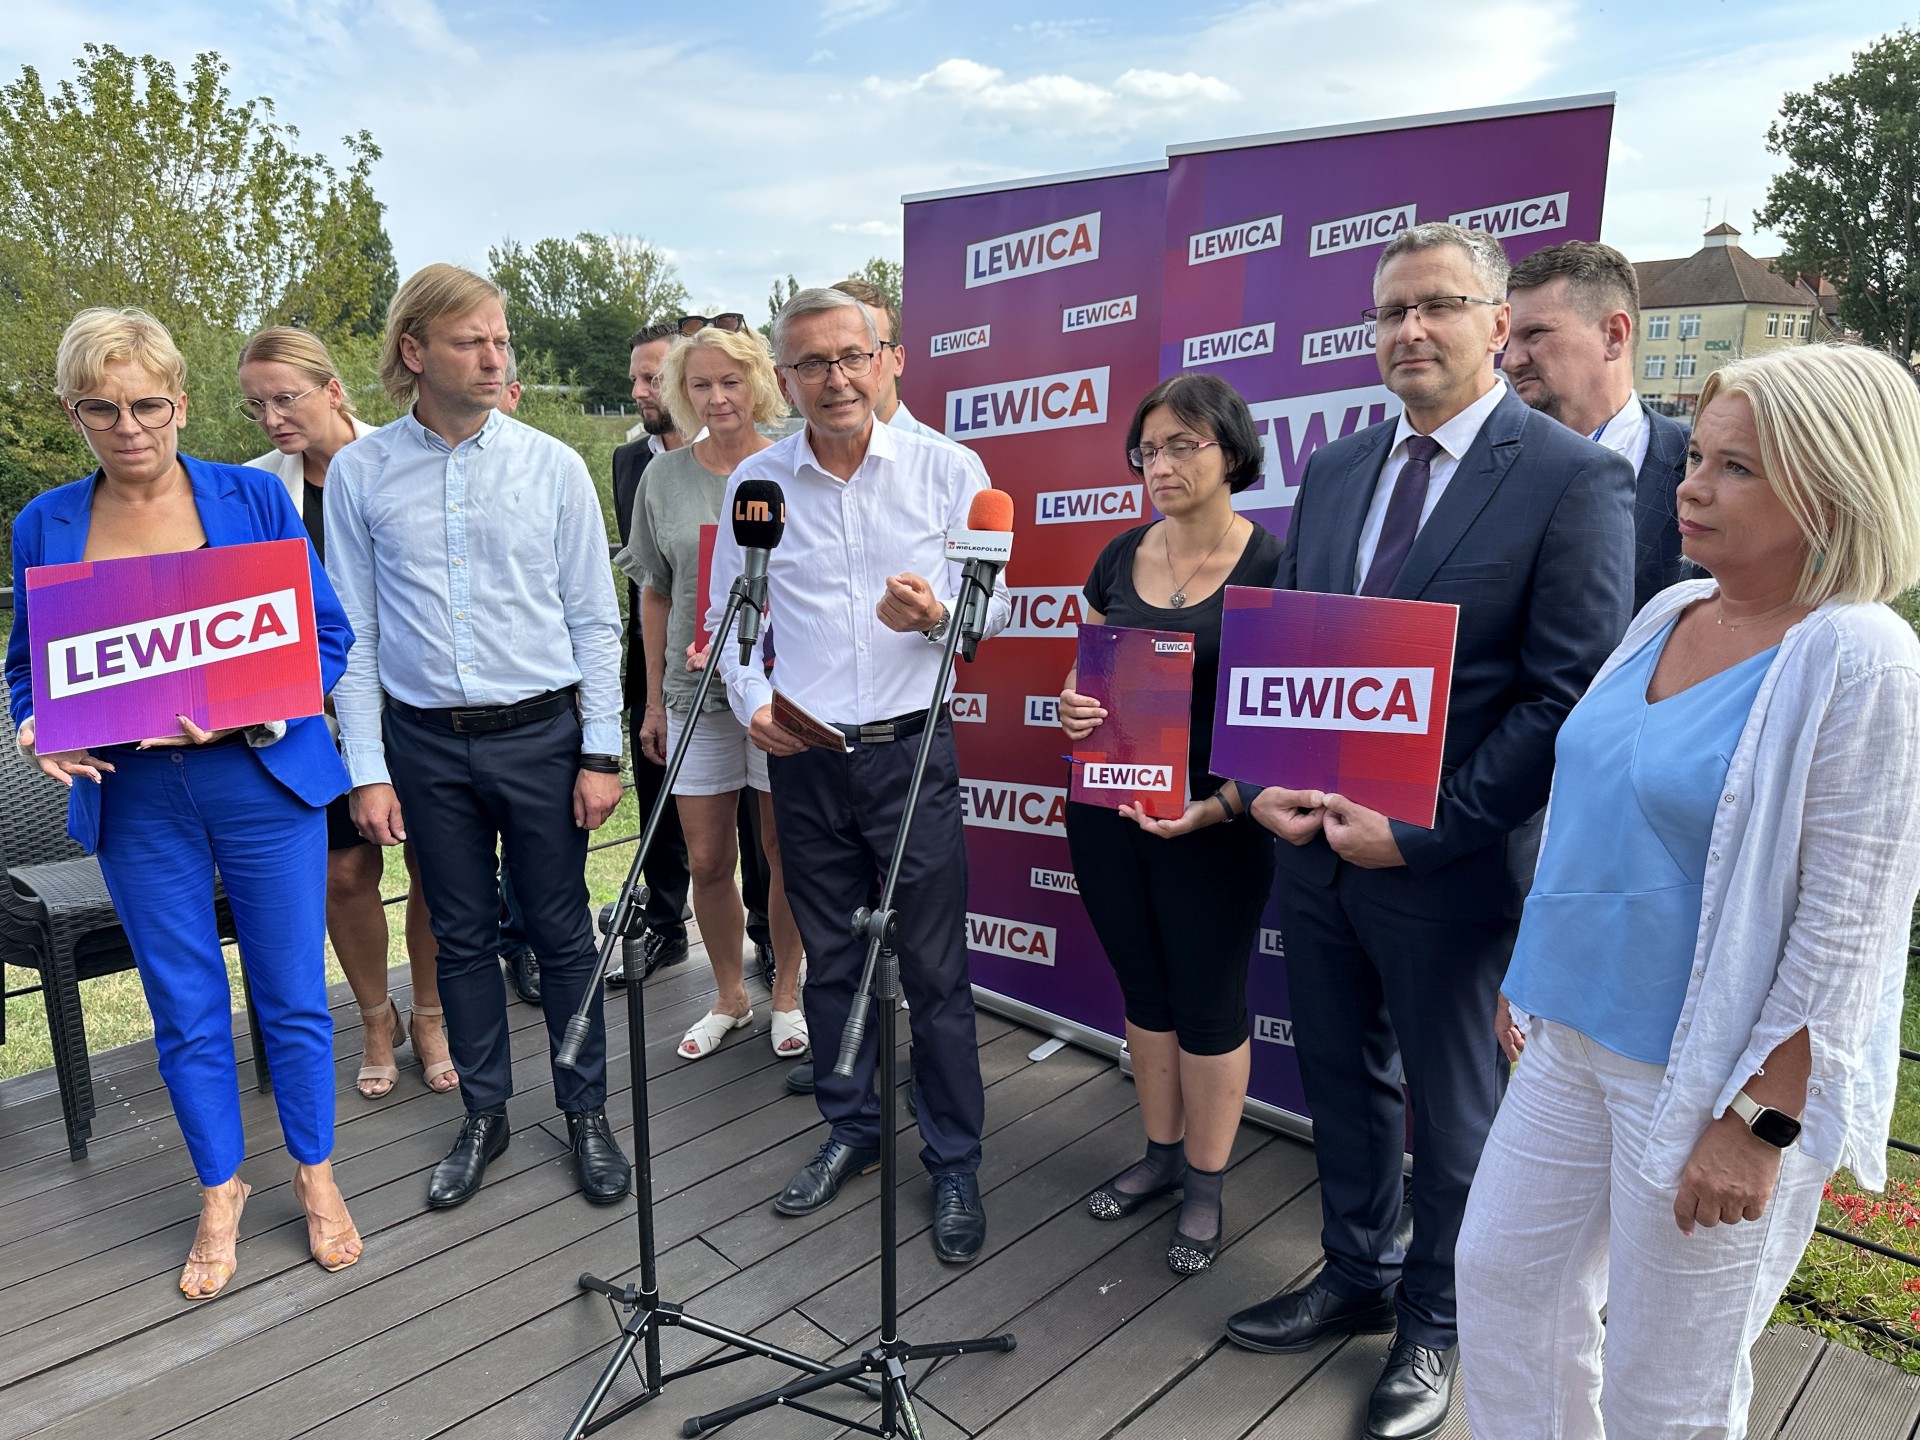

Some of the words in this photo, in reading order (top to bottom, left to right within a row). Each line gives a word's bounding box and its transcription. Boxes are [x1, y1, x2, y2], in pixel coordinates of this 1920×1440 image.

[1194, 222, 1277, 260] LEWICA
[1316, 211, 1408, 250] LEWICA
[973, 223, 1092, 280] LEWICA
[1067, 300, 1133, 328] LEWICA
[934, 329, 987, 353] LEWICA
[1188, 329, 1269, 362] LEWICA
[1308, 329, 1377, 359] LEWIC
[954, 378, 1098, 432] LEWICA
[1041, 491, 1136, 519] LEWICA
[65, 602, 288, 686] LEWICA
[1157, 642, 1190, 651] LEWICA
[1239, 677, 1418, 722] LEWICA
[1089, 766, 1167, 787] LEWICA
[1034, 871, 1079, 891] LEWIC
[965, 918, 1049, 959] WICA
